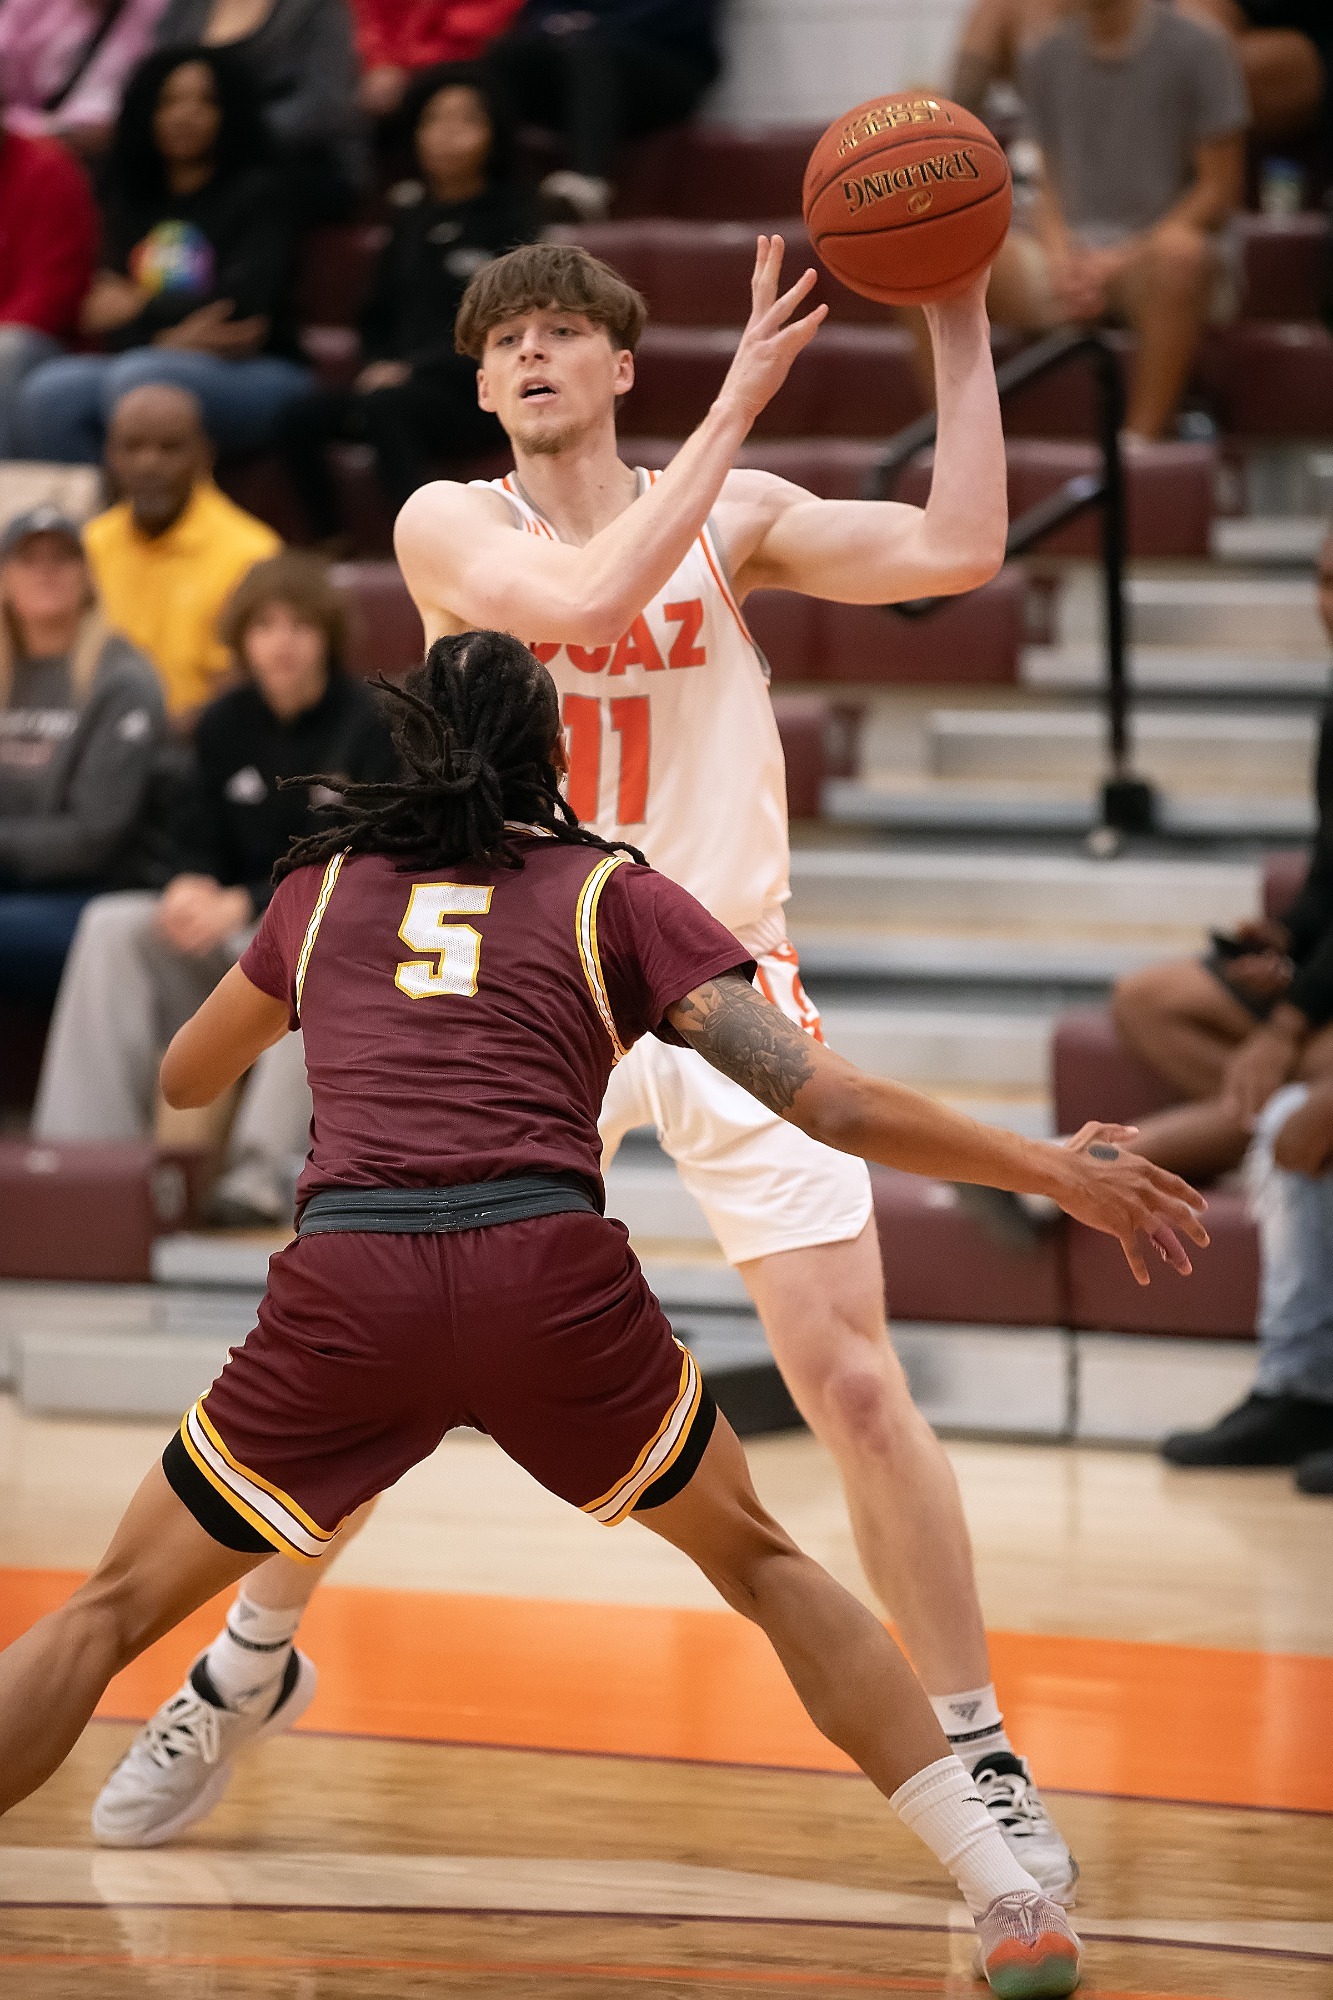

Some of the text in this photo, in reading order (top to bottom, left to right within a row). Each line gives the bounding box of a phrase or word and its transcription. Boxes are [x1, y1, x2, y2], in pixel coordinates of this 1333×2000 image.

[842, 146, 979, 215] SPALDING
[562, 692, 651, 826] 11
[394, 881, 496, 1000] 5
